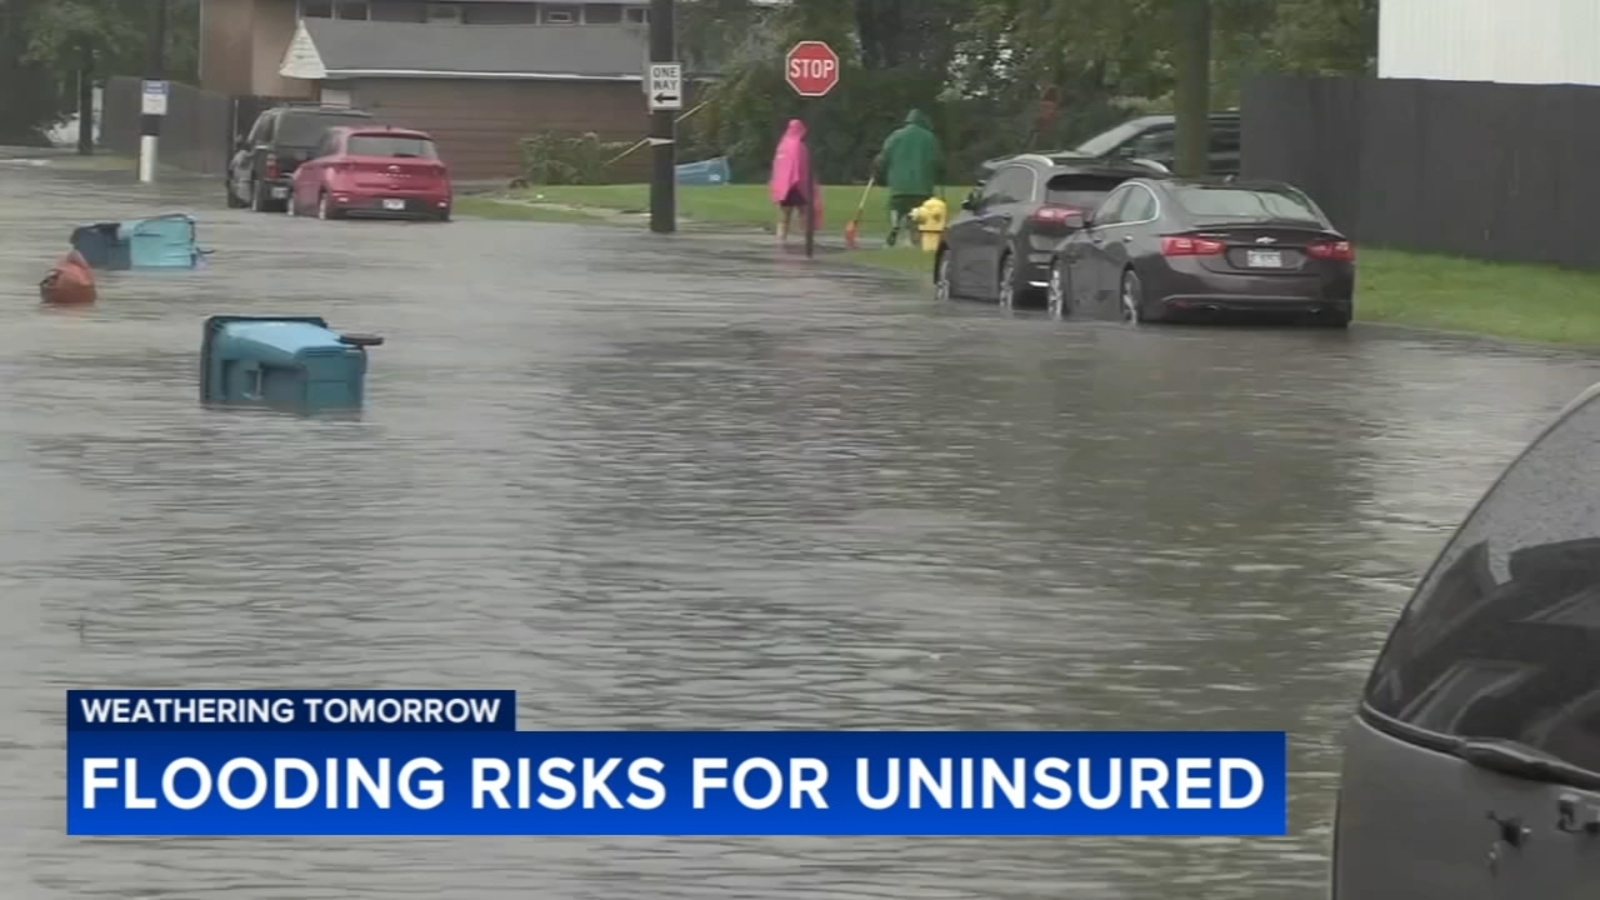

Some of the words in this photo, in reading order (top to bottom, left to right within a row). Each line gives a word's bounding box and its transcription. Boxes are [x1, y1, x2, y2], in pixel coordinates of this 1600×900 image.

[652, 67, 677, 78] ONE
[790, 58, 835, 79] STOP
[653, 80, 678, 90] WAY
